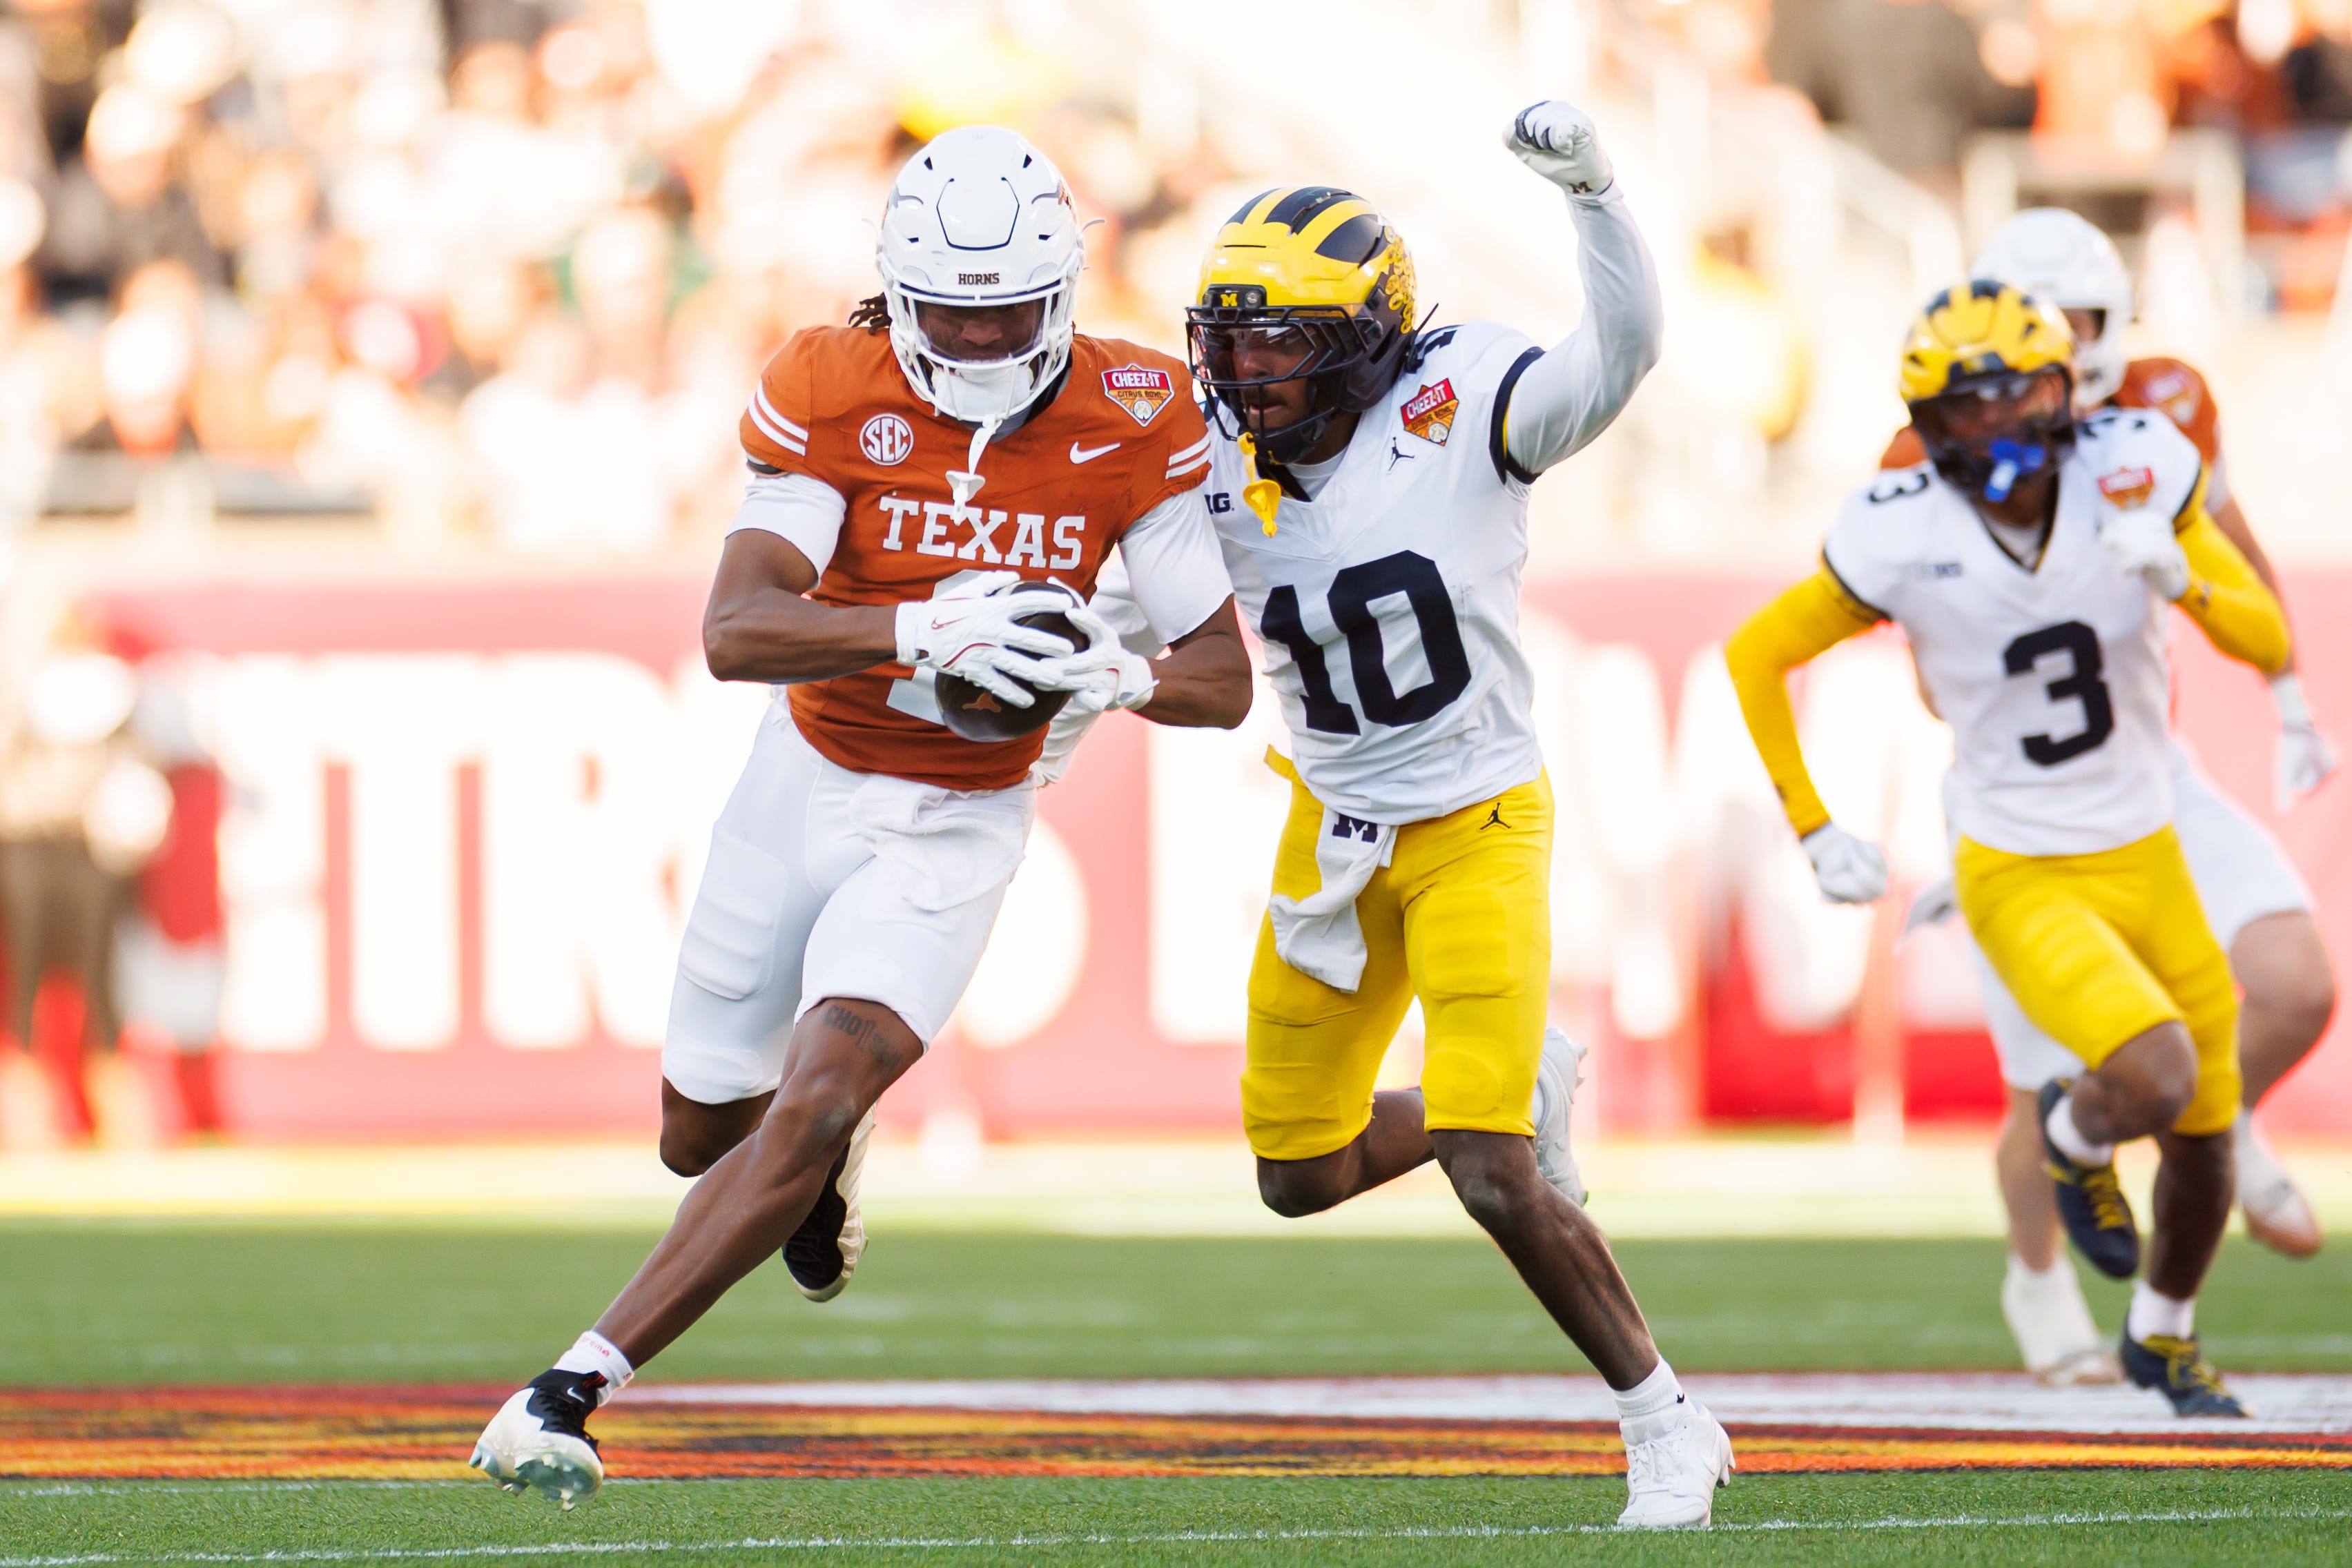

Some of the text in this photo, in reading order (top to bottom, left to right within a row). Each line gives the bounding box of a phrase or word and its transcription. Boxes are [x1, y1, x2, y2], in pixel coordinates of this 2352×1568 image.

[958, 273, 1000, 285] HORNS
[1220, 293, 1238, 307] M
[1118, 390, 1164, 399] CITRUS BOWL
[864, 418, 909, 462] SEC
[878, 496, 1086, 571] TEXAS
[1260, 549, 1472, 736] 10
[2001, 618, 2116, 768] 3
[1332, 813, 1378, 843] M
